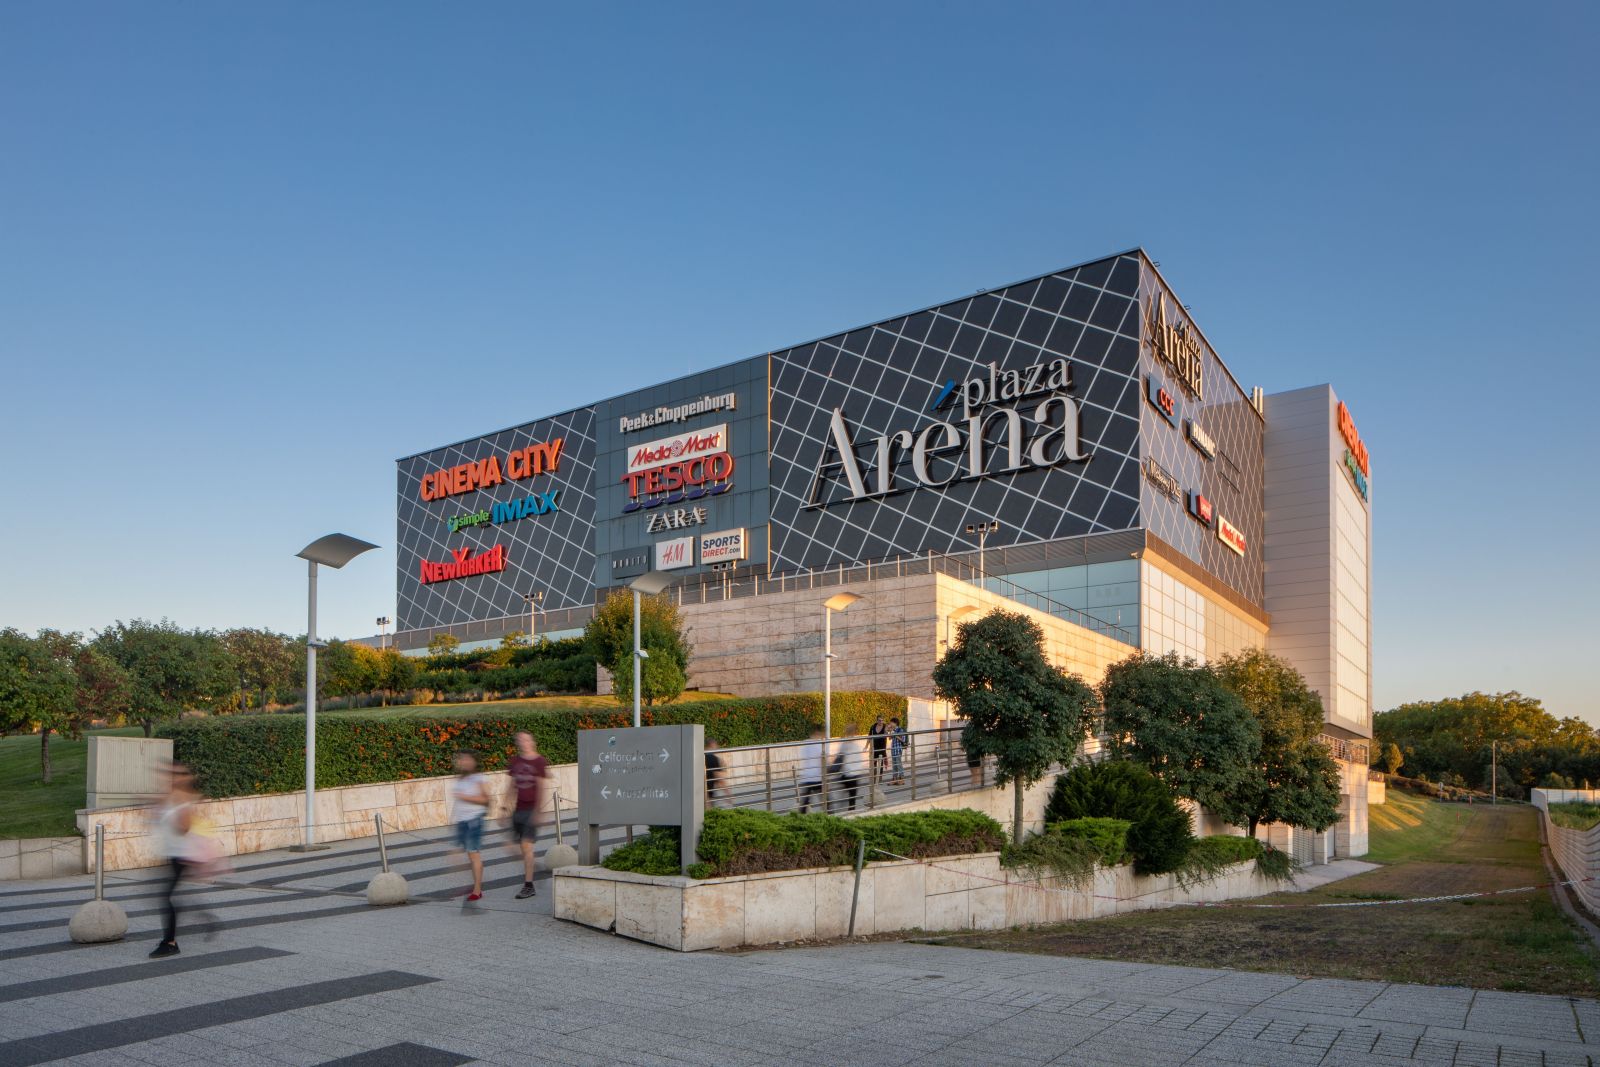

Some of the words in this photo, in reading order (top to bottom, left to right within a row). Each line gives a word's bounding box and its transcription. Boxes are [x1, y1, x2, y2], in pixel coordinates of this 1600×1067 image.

[960, 358, 1073, 421] plaza
[1159, 387, 1175, 416] CCC
[631, 445, 672, 467] Media
[680, 432, 722, 456] Markt
[420, 455, 502, 502] CINEMA
[507, 438, 562, 480] CITY
[620, 452, 735, 498] TESCO
[491, 489, 560, 525] IMAX
[646, 506, 705, 533] ZARA
[662, 543, 685, 565] H&M
[702, 534, 741, 550] SPORTS
